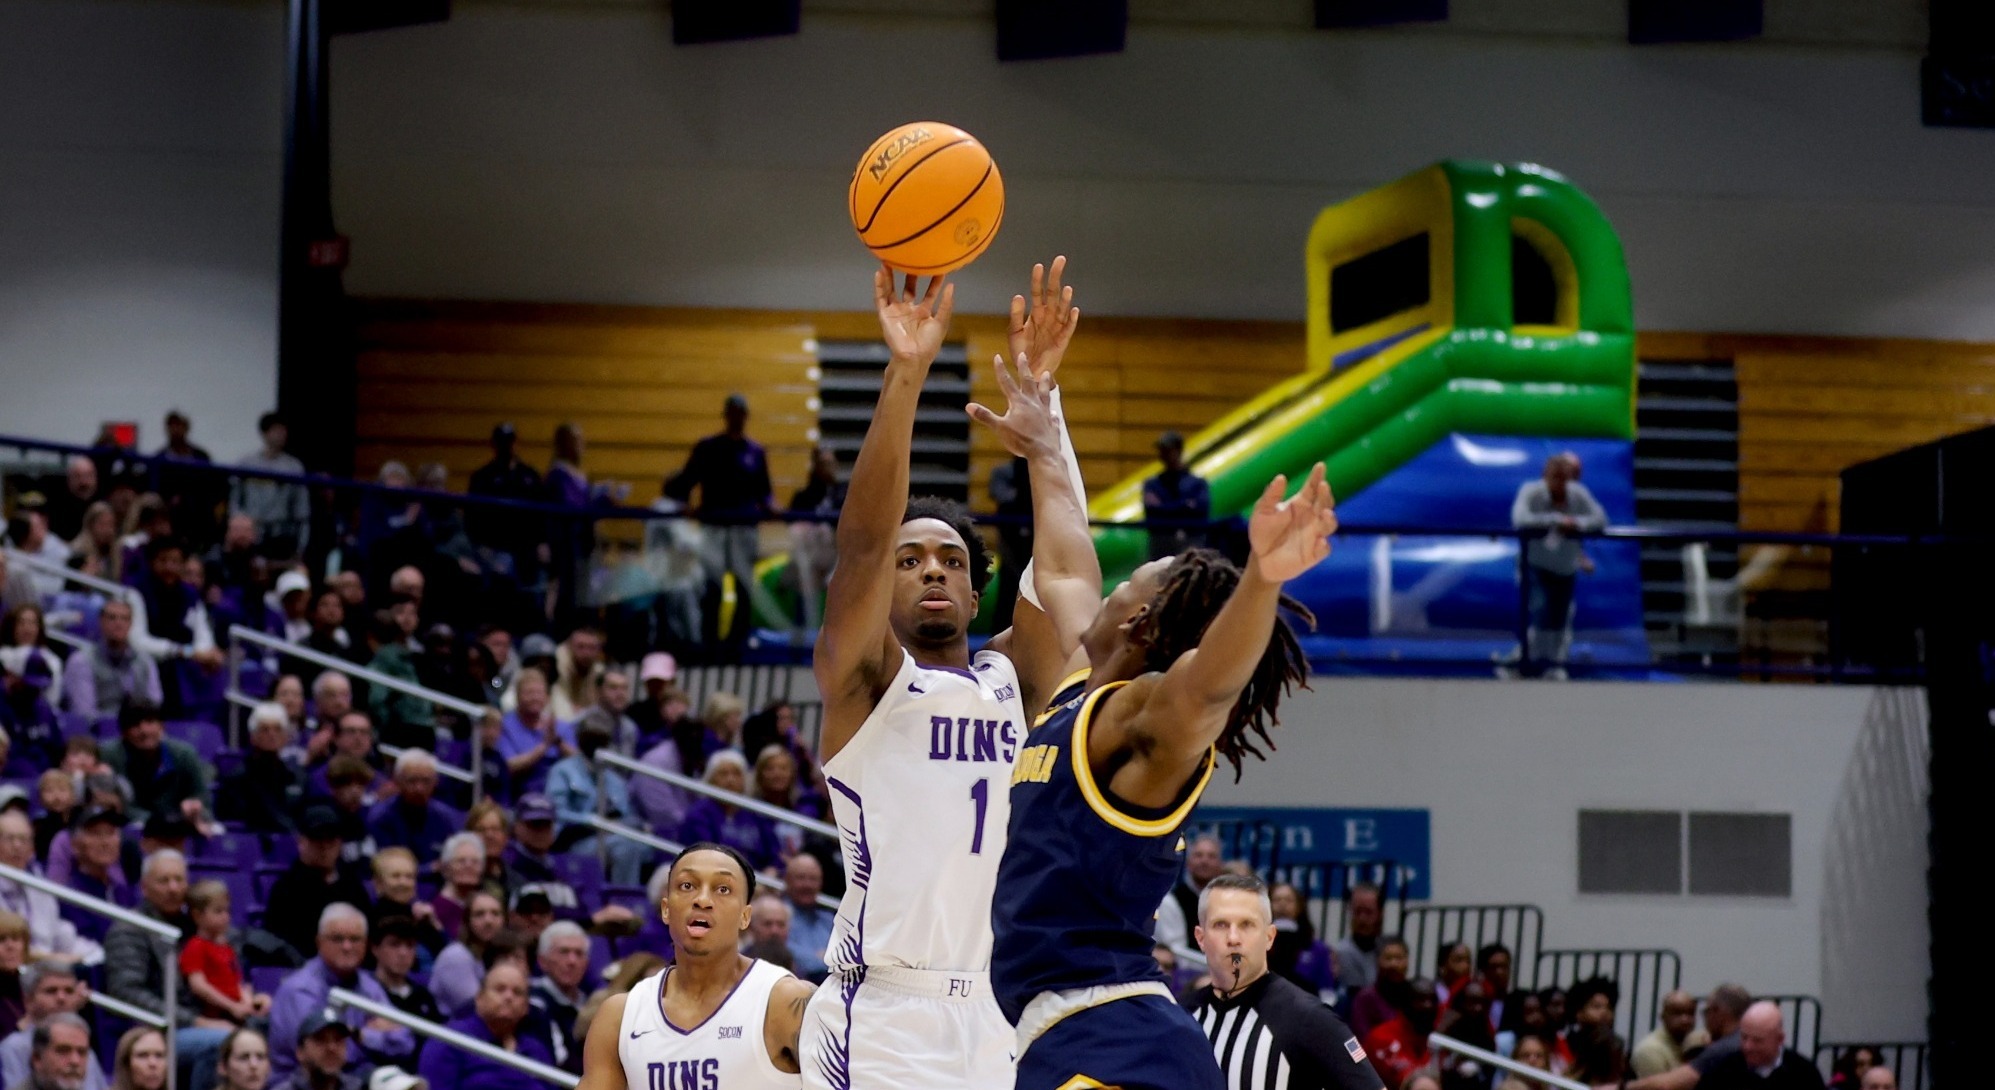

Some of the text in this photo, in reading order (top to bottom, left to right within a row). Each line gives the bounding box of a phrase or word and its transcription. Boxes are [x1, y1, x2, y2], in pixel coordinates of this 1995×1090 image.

[869, 126, 935, 185] NCAA
[929, 715, 1017, 764] DINS
[969, 776, 989, 856] 1
[1344, 818, 1378, 849] E
[947, 978, 973, 998] FU
[717, 1025, 743, 1040] SOCON
[647, 1057, 719, 1090] DINS
